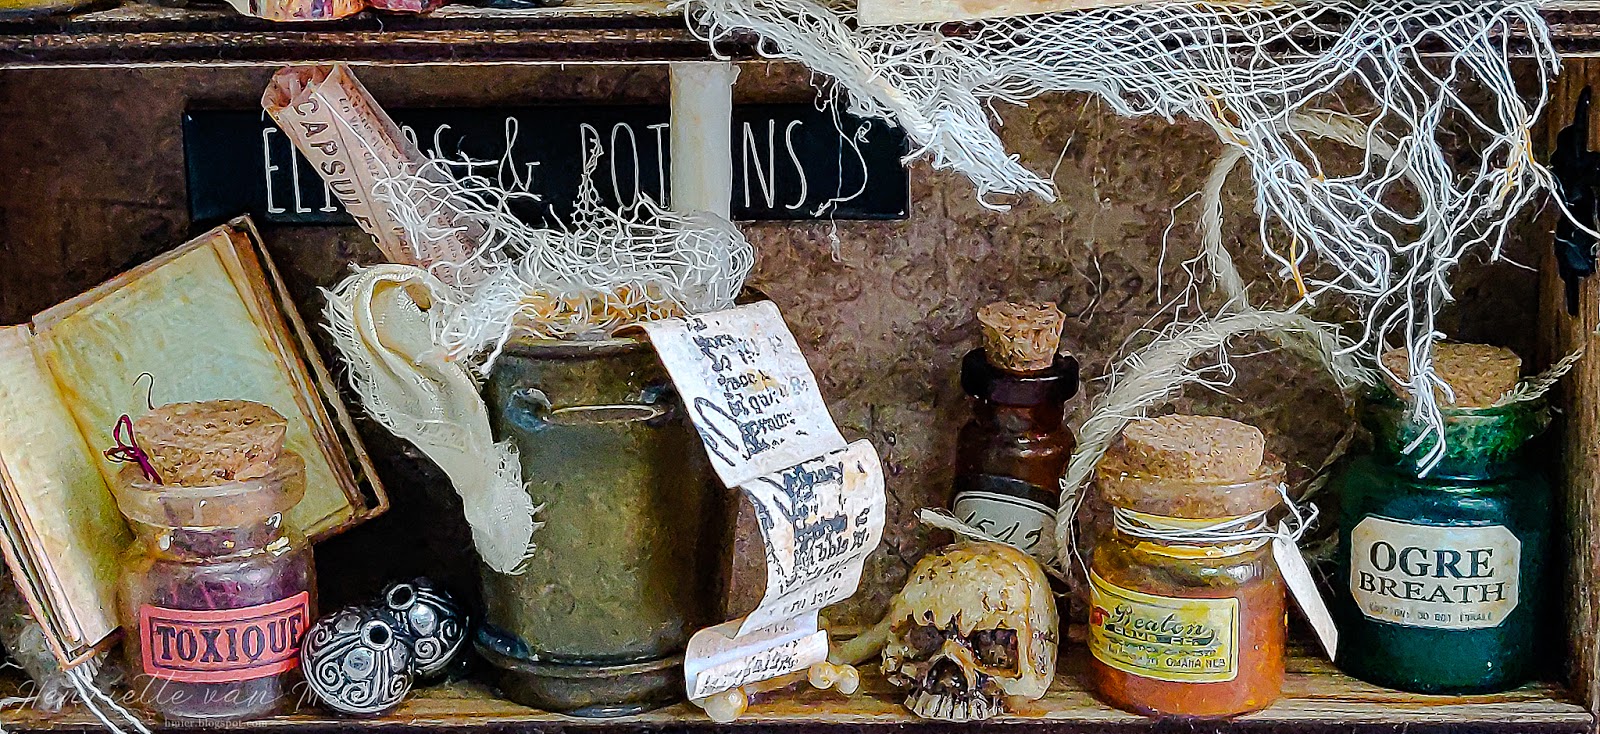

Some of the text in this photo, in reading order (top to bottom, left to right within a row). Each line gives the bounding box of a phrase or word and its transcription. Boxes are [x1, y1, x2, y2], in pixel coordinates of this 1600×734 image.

[290, 97, 381, 244] CAPSUL
[580, 119, 807, 212] POTNS
[1369, 541, 1495, 579] OGRE
[1358, 570, 1507, 605] BREATH
[156, 615, 302, 663] TOXIQUE
